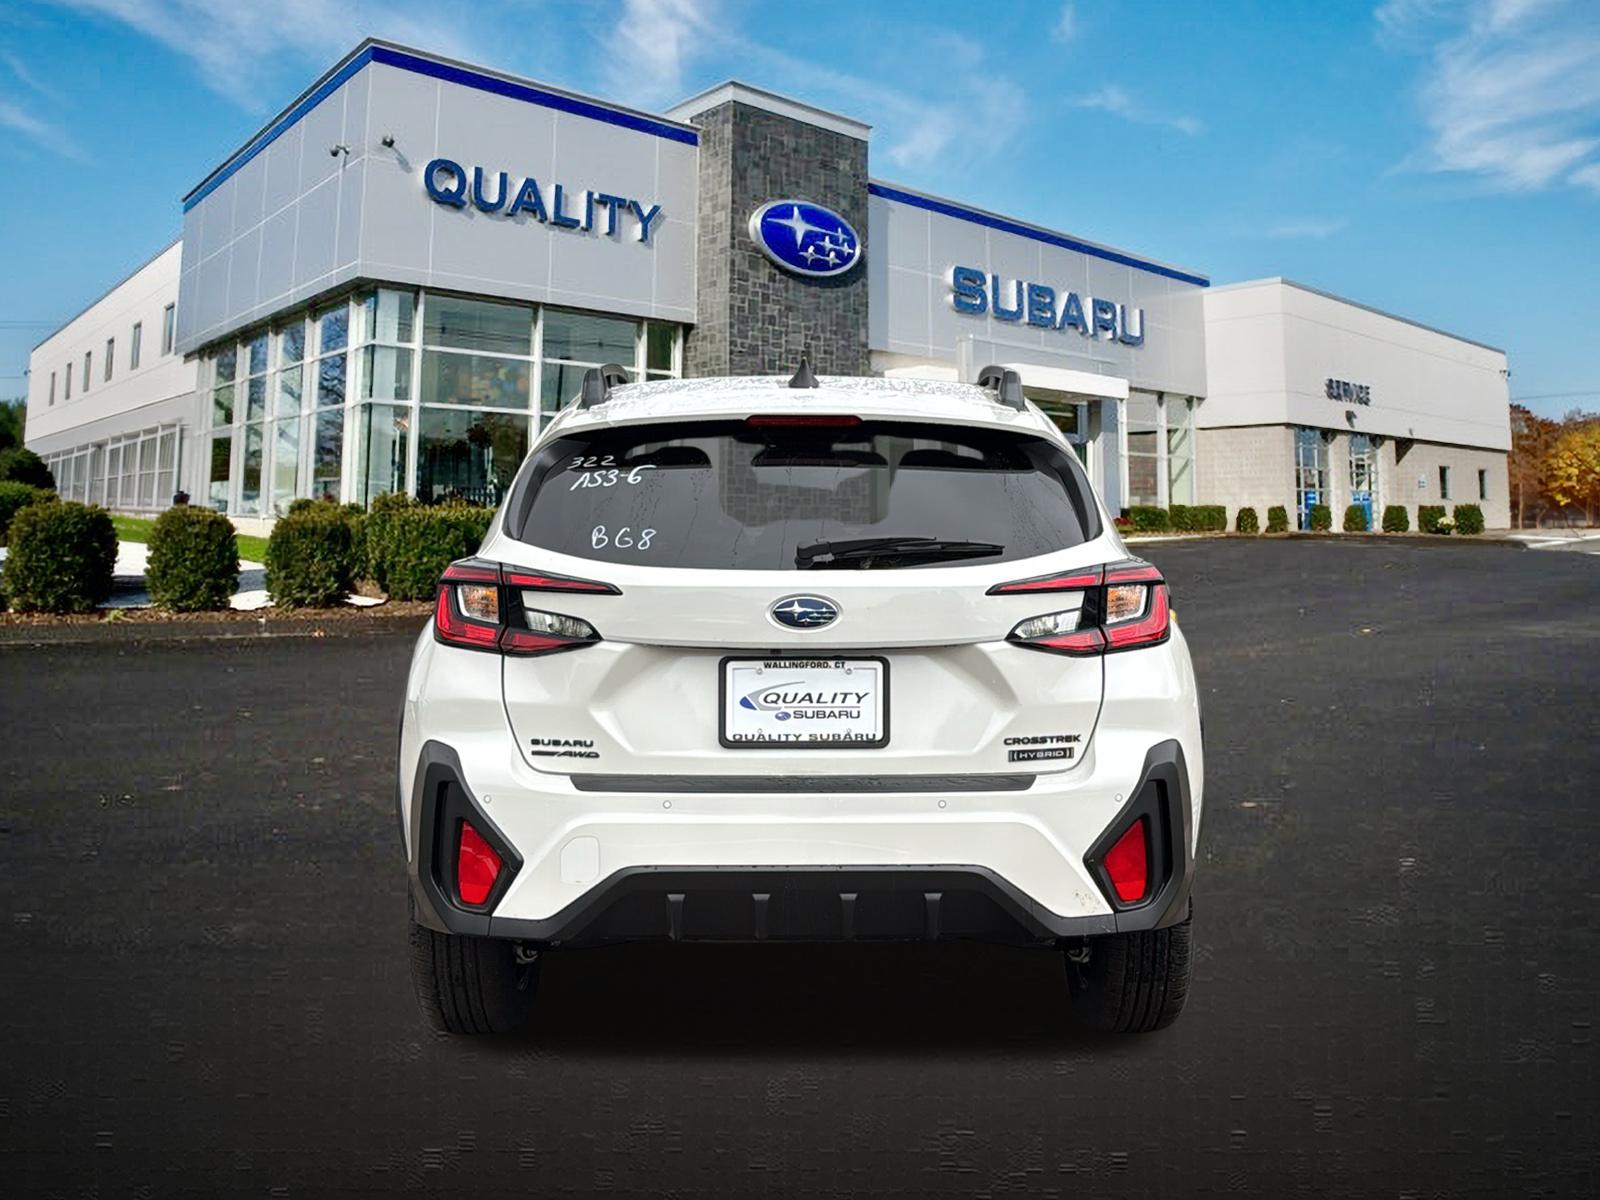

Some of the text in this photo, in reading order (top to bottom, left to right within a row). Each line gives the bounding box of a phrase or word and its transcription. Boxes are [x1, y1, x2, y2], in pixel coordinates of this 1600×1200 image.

[423, 158, 662, 243] QUALITY
[947, 265, 1145, 347] SUBARU
[1324, 377, 1371, 407] SERVICE
[567, 455, 617, 469] 322
[834, 661, 846, 669] CT
[763, 692, 870, 704] QUALITY
[793, 710, 861, 719] SUBARU
[530, 739, 594, 747] SUBARU
[732, 733, 877, 741] QUALITY SUBARU
[1003, 734, 1081, 746] CROSSTREK
[556, 750, 600, 758] AWD
